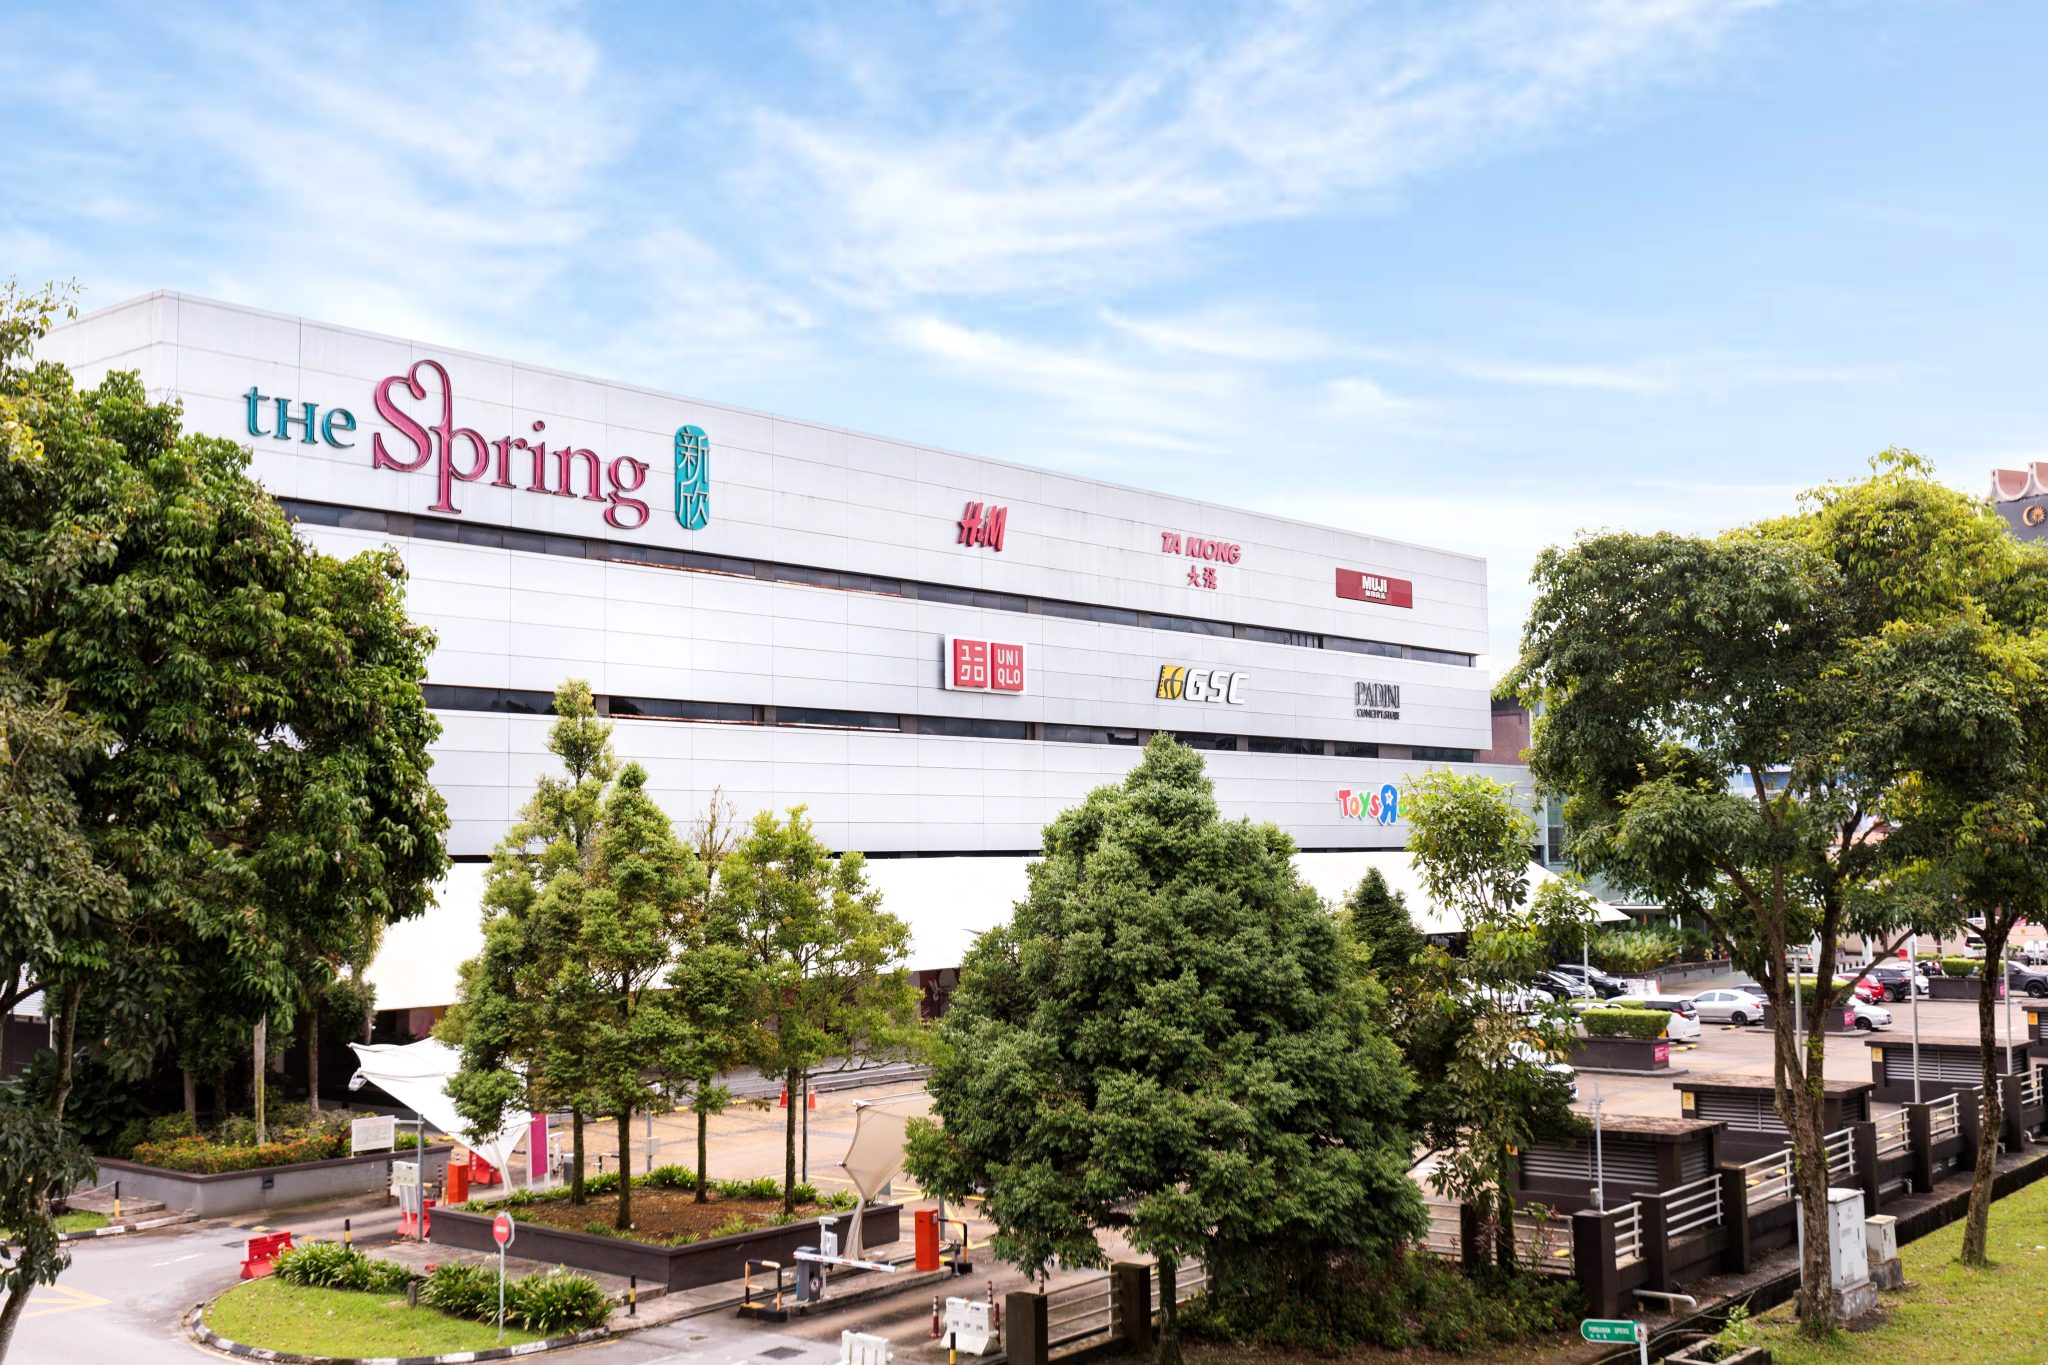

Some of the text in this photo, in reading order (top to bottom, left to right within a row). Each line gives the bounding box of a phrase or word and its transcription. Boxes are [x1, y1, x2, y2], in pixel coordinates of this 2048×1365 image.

[374, 359, 650, 529] Spring
[677, 425, 710, 529] 新欣
[958, 501, 1008, 552] H&M
[1162, 532, 1241, 564] TA KIONG
[1362, 575, 1388, 593] MUJI
[1184, 668, 1250, 705] GSC
[1355, 681, 1400, 709] PADINI
